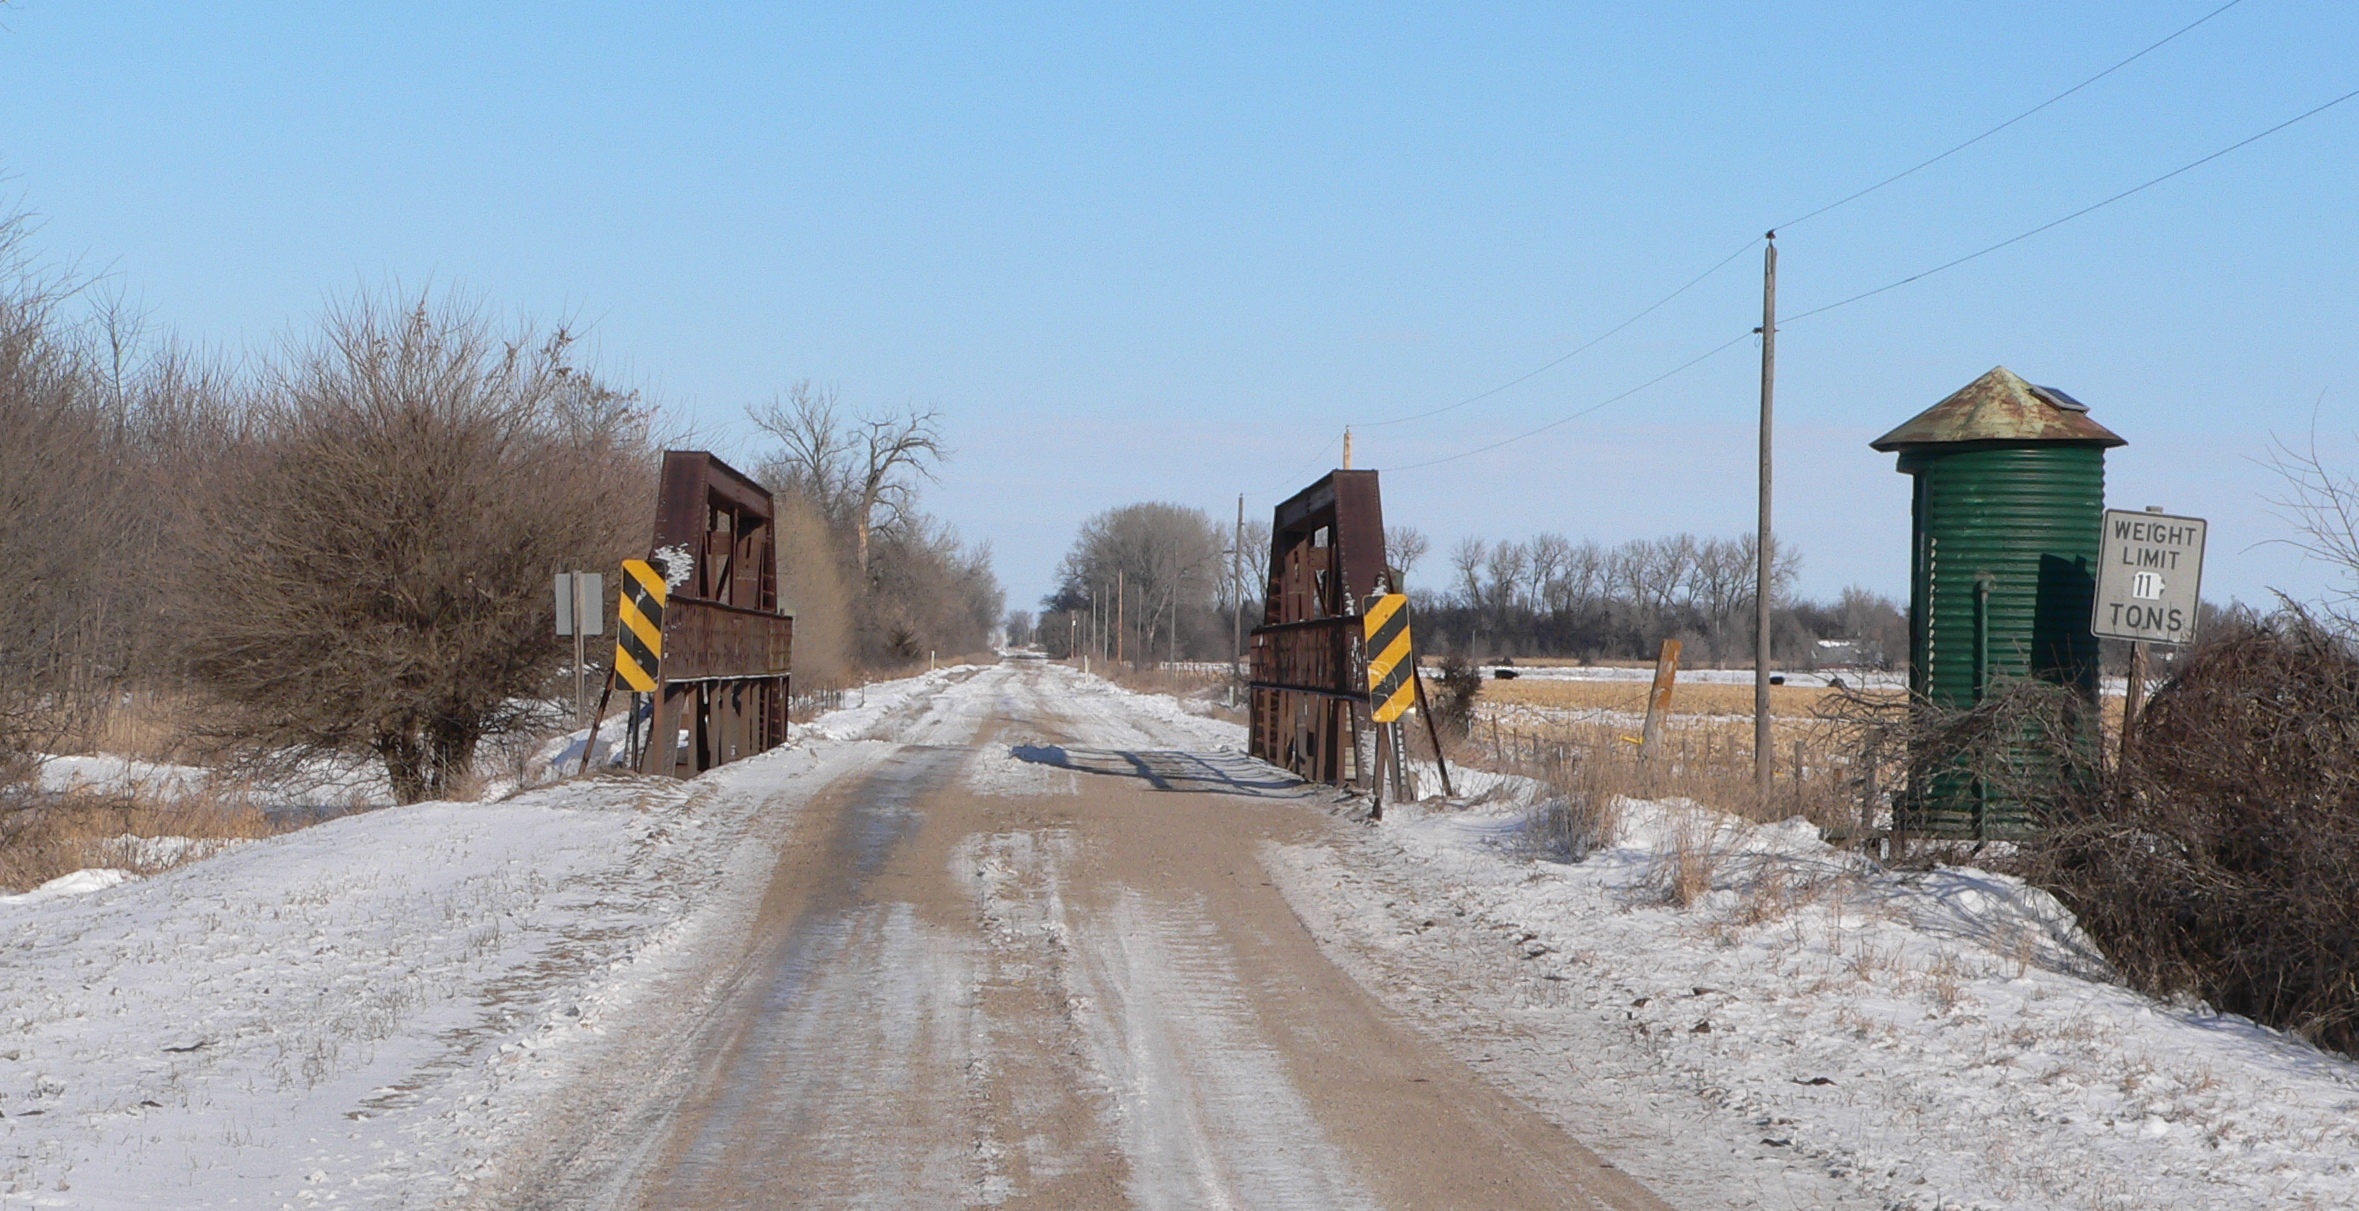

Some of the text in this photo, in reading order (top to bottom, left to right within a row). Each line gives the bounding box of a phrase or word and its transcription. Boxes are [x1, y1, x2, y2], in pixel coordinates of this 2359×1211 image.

[2115, 520, 2196, 546] WEIGHT
[2122, 546, 2180, 570] LIMIT
[2136, 574, 2151, 597] 11
[2109, 603, 2182, 631] TONS
